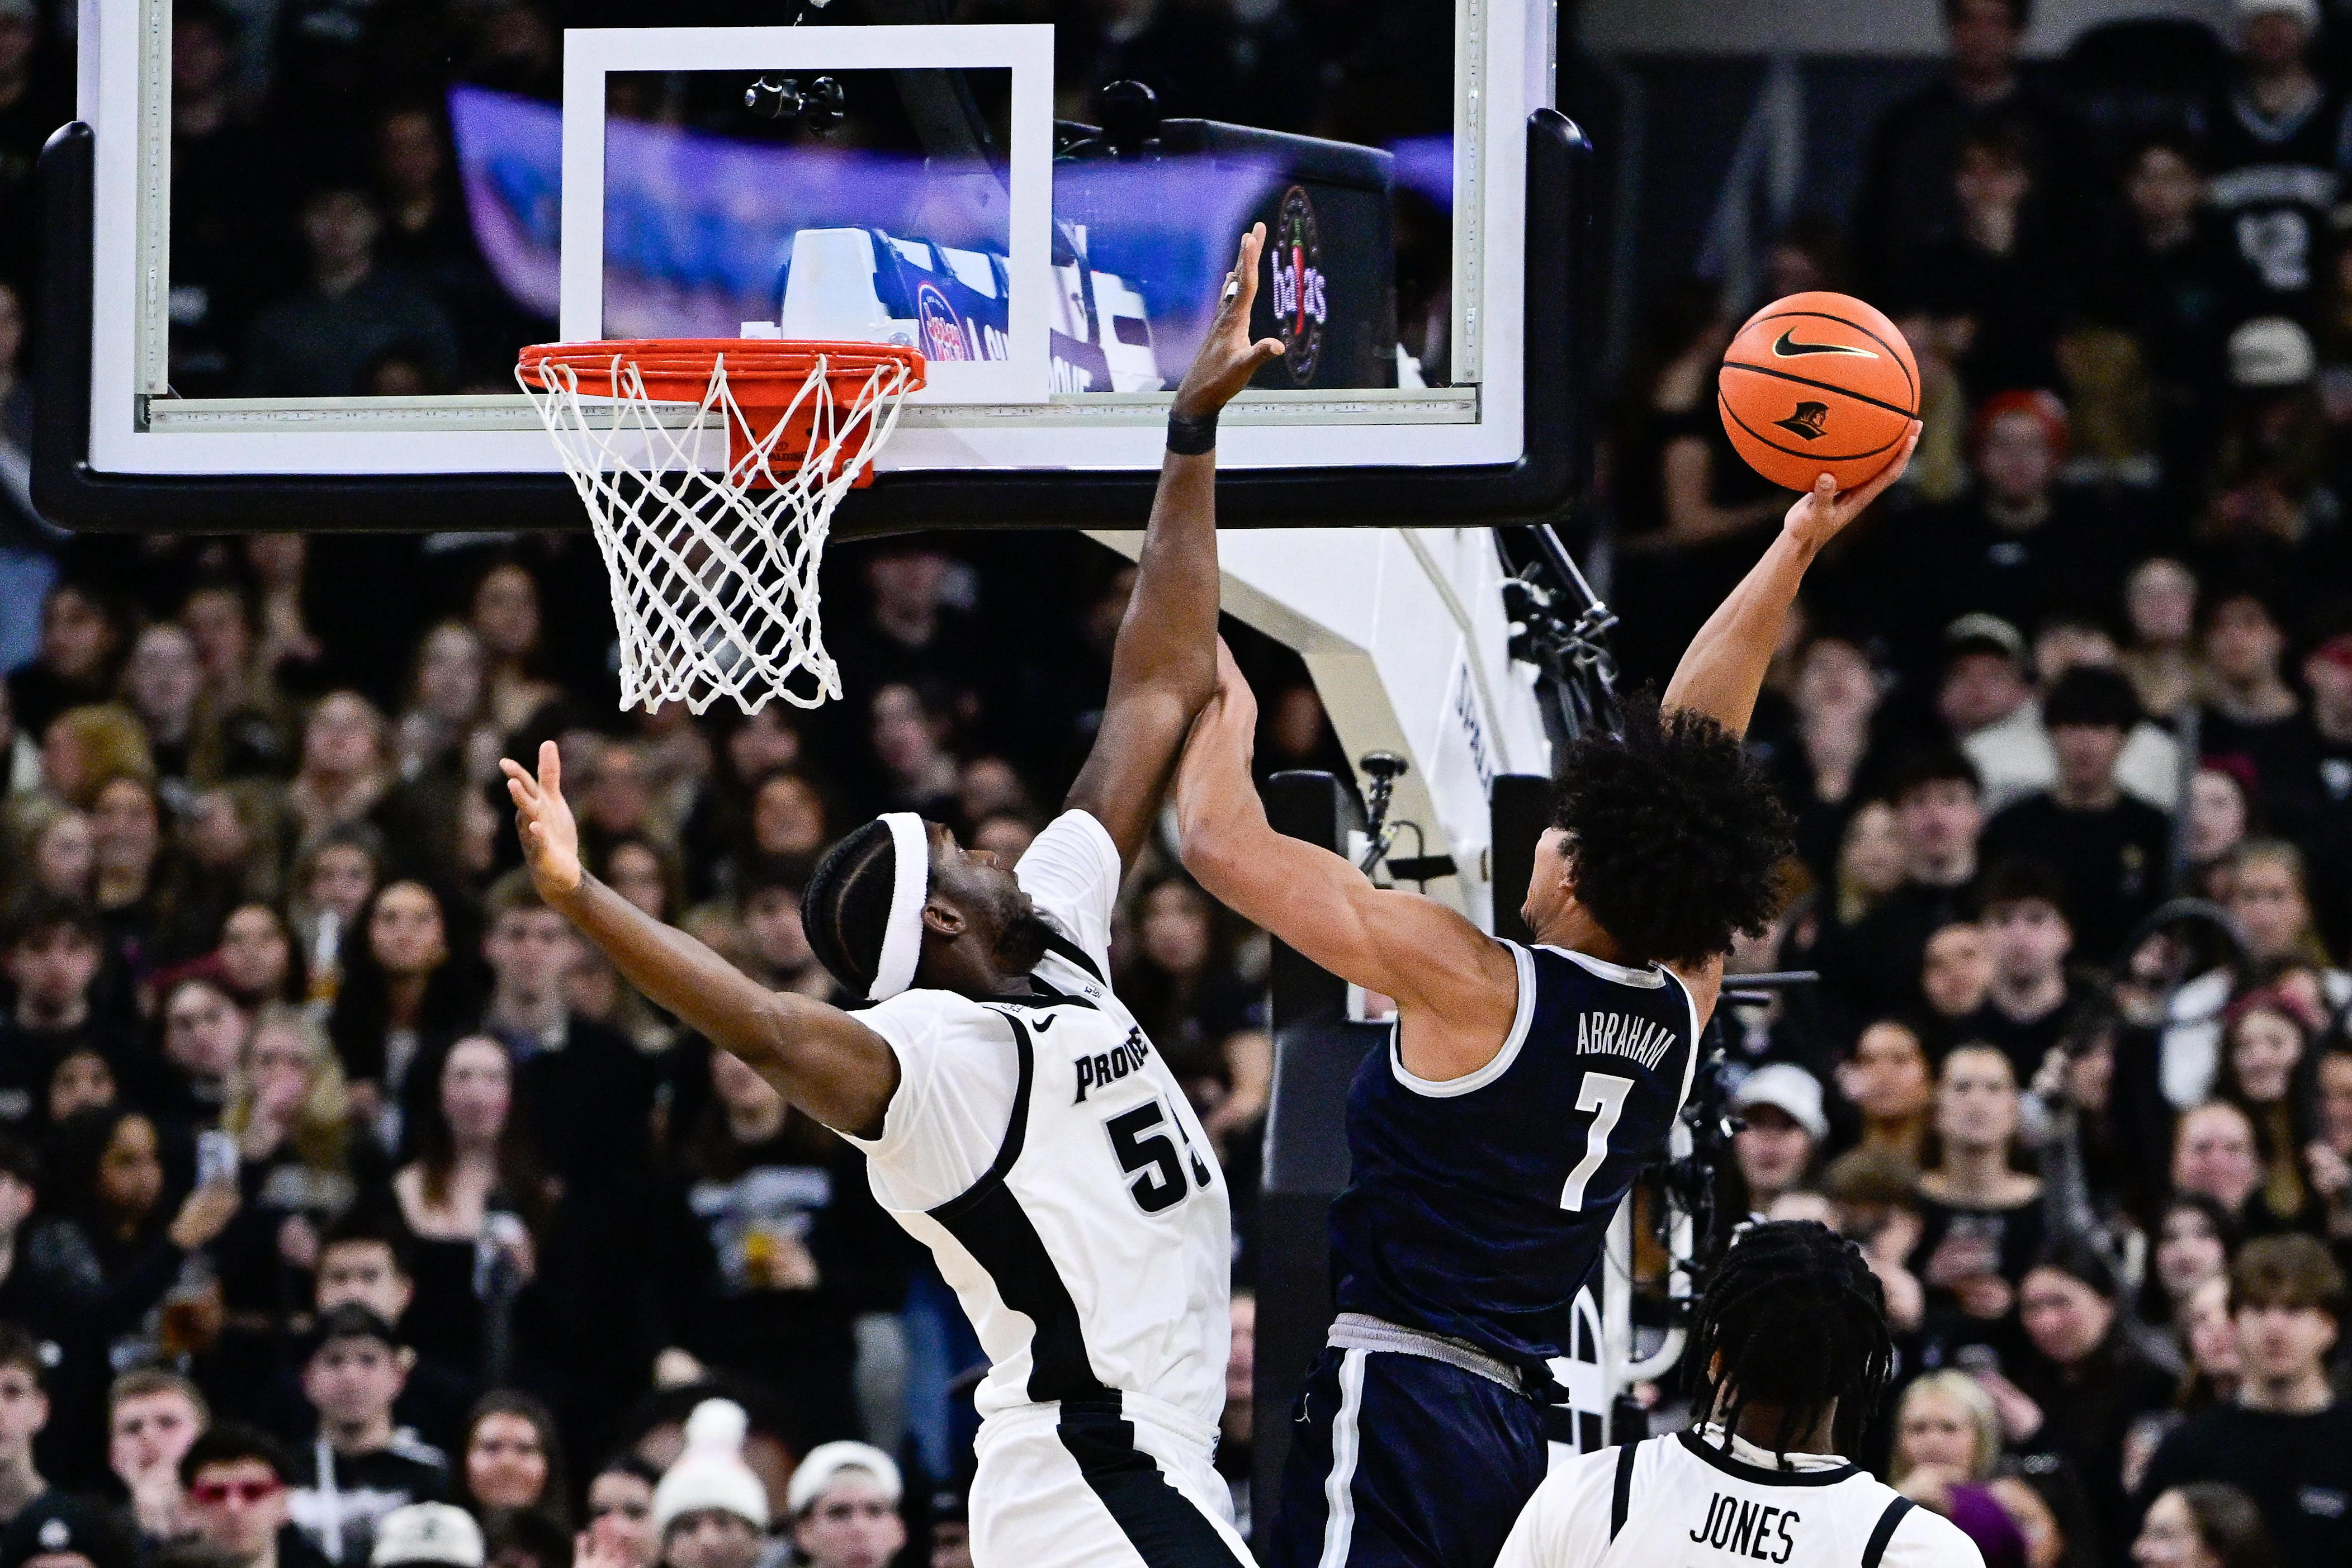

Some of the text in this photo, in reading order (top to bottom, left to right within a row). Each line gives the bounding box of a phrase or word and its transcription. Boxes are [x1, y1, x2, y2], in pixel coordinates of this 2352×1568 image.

[1576, 1011, 1677, 1071] ABRAHAM
[1101, 1093, 1213, 1218] 5
[1560, 1071, 1635, 1212] 7
[1690, 1492, 1800, 1564] JONES
